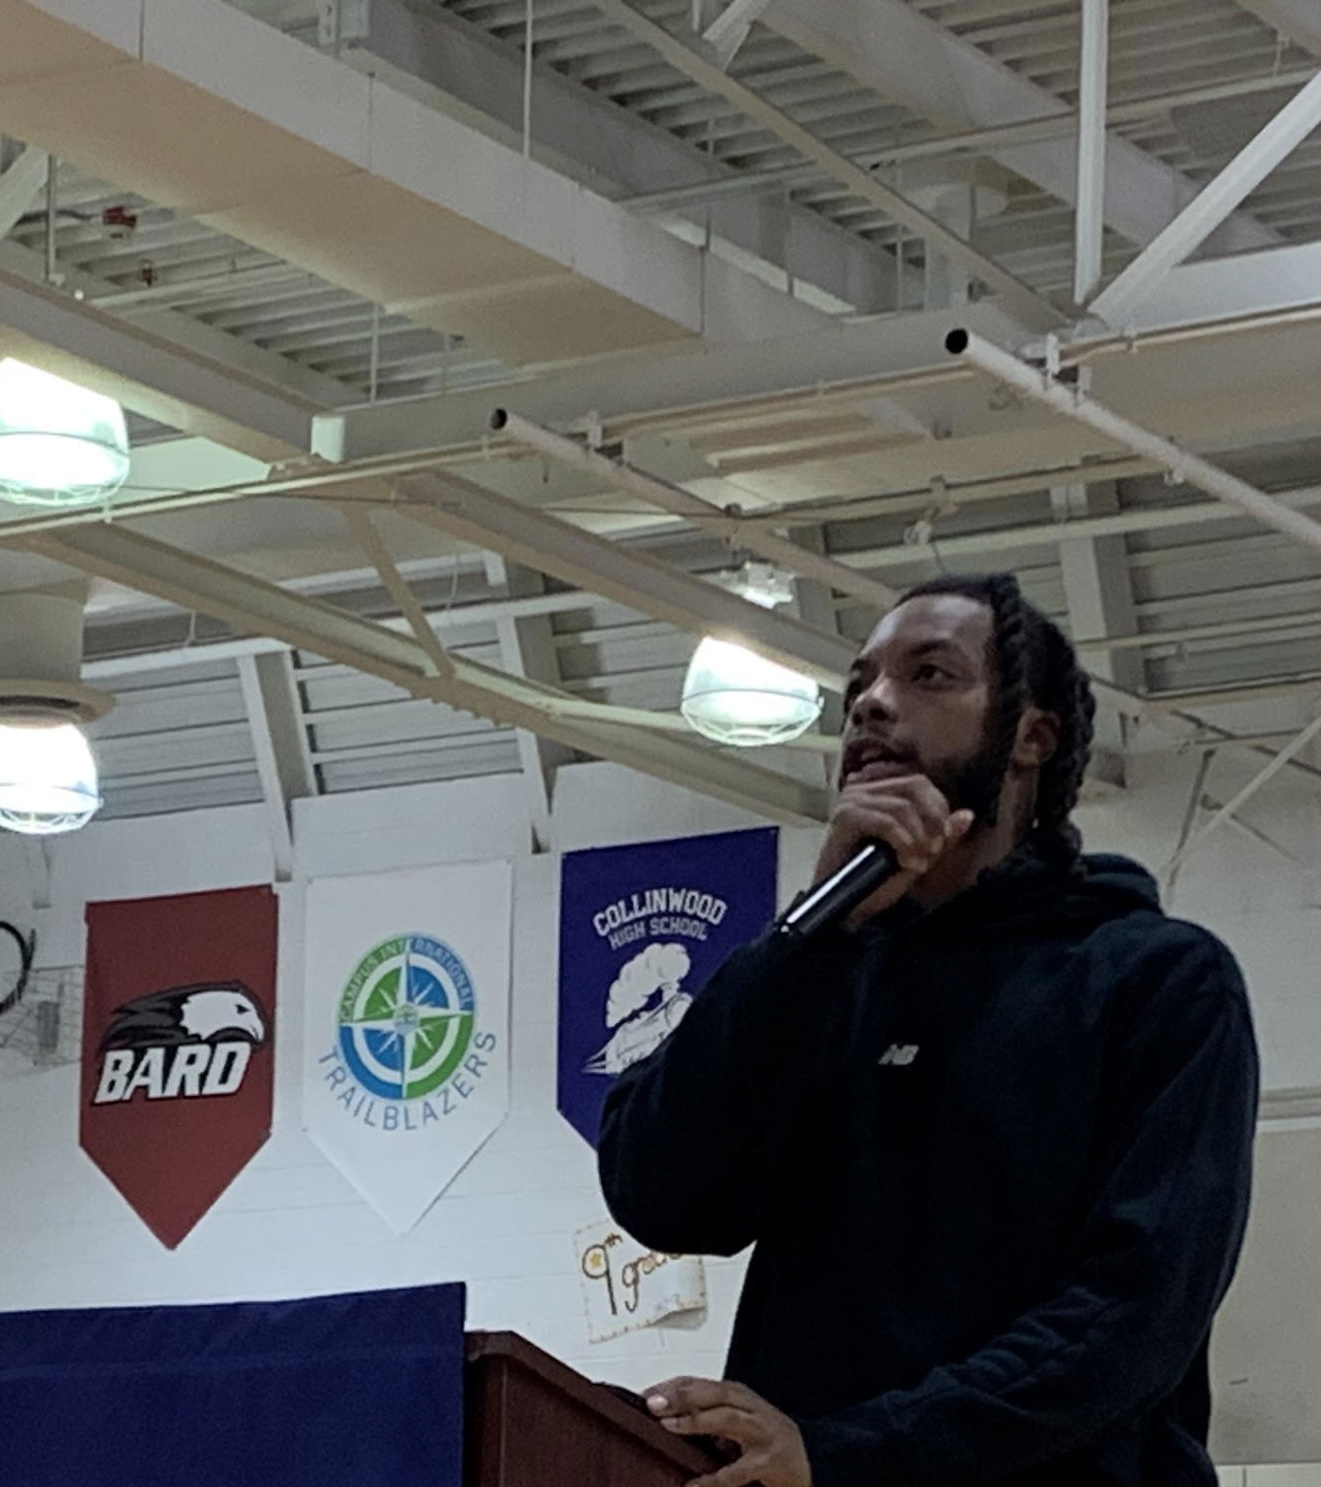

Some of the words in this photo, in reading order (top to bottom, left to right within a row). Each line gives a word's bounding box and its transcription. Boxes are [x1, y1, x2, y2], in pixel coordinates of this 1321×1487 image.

[593, 888, 728, 937] COLLINWOOD
[608, 921, 646, 950] HIGH
[649, 917, 708, 942] SCHOOL
[340, 955, 380, 1021] CAMPUS
[92, 1041, 253, 1104] BARD
[318, 1031, 497, 1131] TRAILBLAZERS
